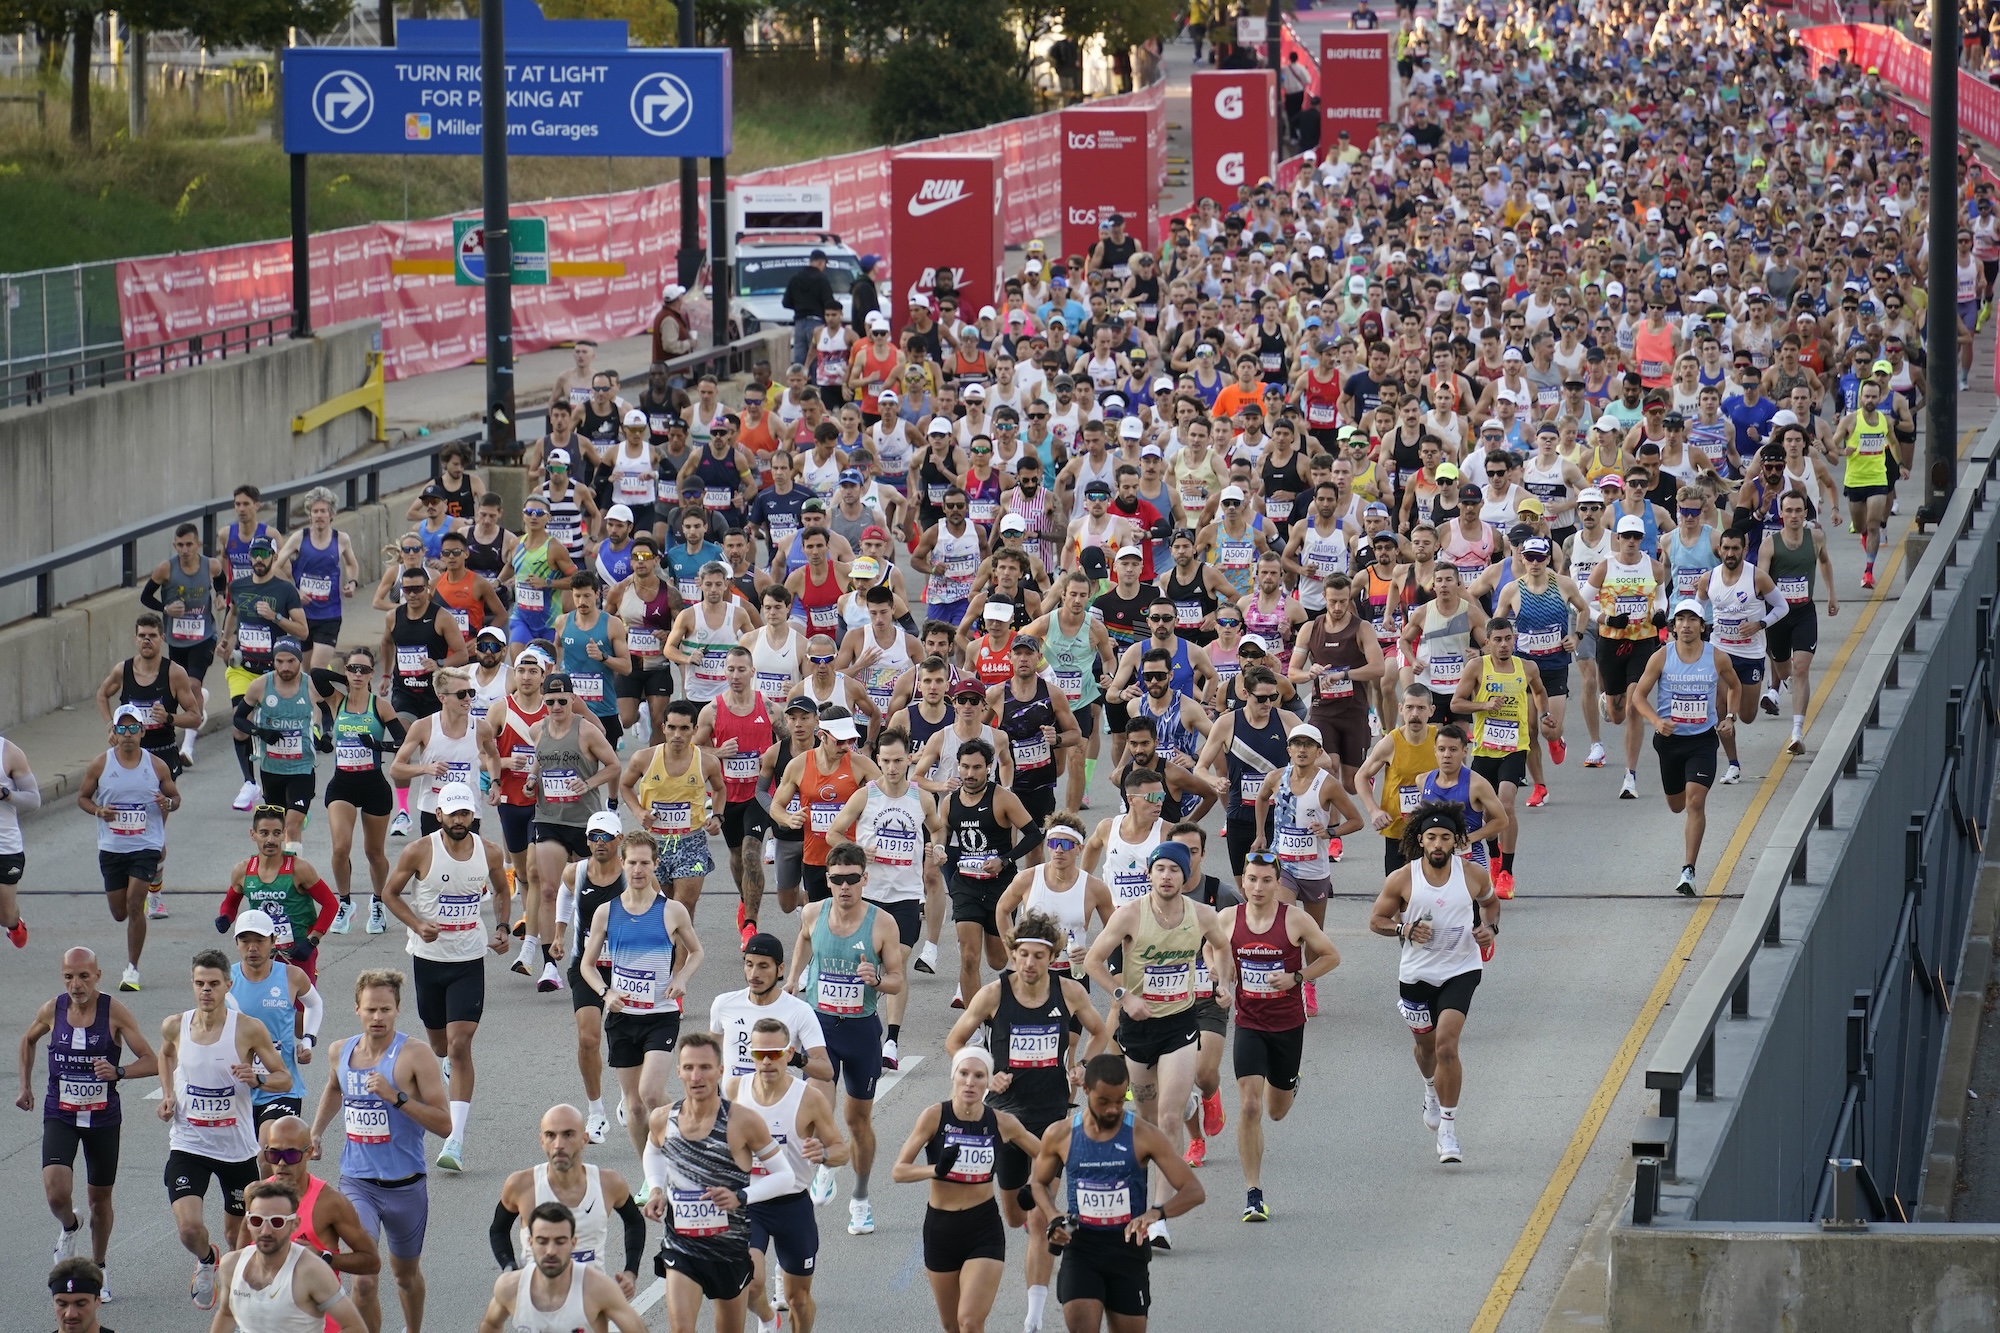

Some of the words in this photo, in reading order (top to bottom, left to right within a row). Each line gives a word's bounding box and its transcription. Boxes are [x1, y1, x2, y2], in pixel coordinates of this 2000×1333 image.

[395, 65, 450, 82] TURN
[456, 66, 516, 82] RIGT
[521, 66, 544, 82] AT
[550, 66, 608, 83] LIGHT
[421, 90, 462, 106] FOR
[468, 90, 554, 108] PKING
[558, 90, 583, 108] AT
[437, 119, 526, 136] Millenum
[531, 121, 598, 141] Garages
[1068, 130, 1095, 149] tcs
[918, 180, 964, 200] RUN
[1068, 206, 1095, 224] tcs
[1862, 440, 1882, 448] A2017
[706, 493, 728, 501] A3026
[1268, 504, 1290, 512] A2152
[1224, 549, 1248, 558] A5067
[946, 562, 974, 572] A21154
[300, 580, 330, 590] A17065
[1780, 584, 1804, 594] A5155
[518, 591, 540, 600] A2135
[1615, 604, 1647, 613] A14200
[814, 610, 838, 620] A3136
[176, 620, 201, 630] A1163
[239, 630, 270, 641] A21134
[630, 635, 656, 644] A5004
[1528, 632, 1559, 645] A14017
[1432, 664, 1460, 674] A3159
[404, 678, 428, 688] Carnes
[1666, 673, 1712, 682] COLLEGEVILLE
[572, 680, 599, 690] A1173
[1058, 680, 1081, 690] 8152
[1669, 684, 1690, 693] TRACK
[1691, 684, 1708, 692] CLUB
[1672, 700, 1706, 712] A18111
[272, 718, 304, 729] GINEX
[338, 724, 371, 733] BRASIL
[1486, 727, 1515, 740] A5075
[275, 738, 298, 748] 1132
[337, 748, 372, 758] A23005
[1018, 743, 1046, 759] A5175
[727, 760, 755, 770] A2012
[435, 771, 466, 782] A9052
[116, 812, 146, 823] 19170
[878, 808, 901, 817] OLYMPIC
[902, 811, 916, 827] COACH
[877, 839, 914, 852] A19193
[1283, 836, 1313, 848] A3050
[250, 890, 286, 900] MÉXICO
[438, 904, 478, 916] A23172
[1237, 944, 1282, 957] playmakers
[616, 978, 650, 993] A2064
[1148, 974, 1185, 988] A9177
[822, 984, 859, 998] A2173
[1401, 1009, 1429, 1022] 3070
[1011, 1037, 1058, 1051] A22119
[55, 1054, 65, 1063] LA
[65, 1084, 103, 1096] A3009
[191, 1098, 231, 1112] A1129
[345, 1110, 386, 1126] A14030
[955, 1147, 993, 1164] 21065
[1082, 1193, 1124, 1208] A9174
[675, 1203, 725, 1219] A23042
